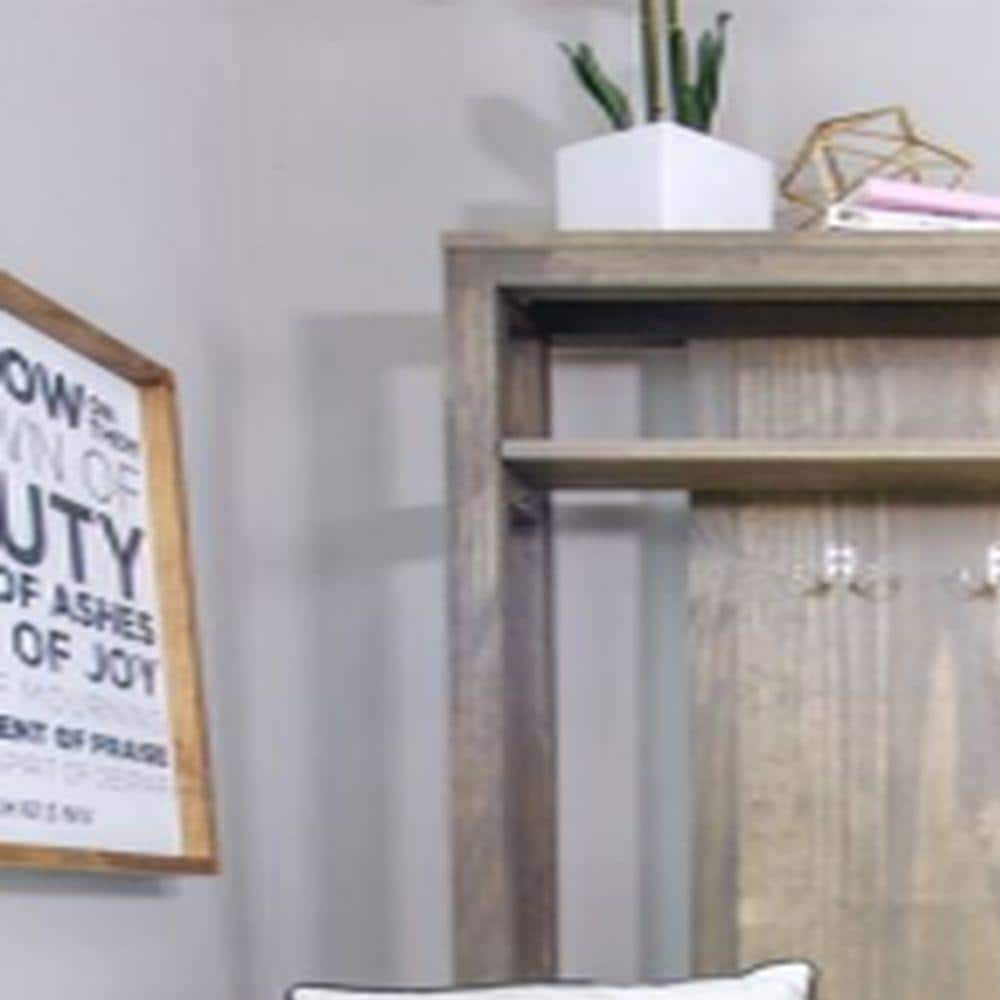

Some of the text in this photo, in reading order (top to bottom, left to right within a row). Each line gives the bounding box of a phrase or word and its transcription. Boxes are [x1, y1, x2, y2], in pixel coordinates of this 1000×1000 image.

[51, 582, 155, 645] ASHES
[12, 620, 159, 696] OF JOY
[54, 724, 87, 752] OF
